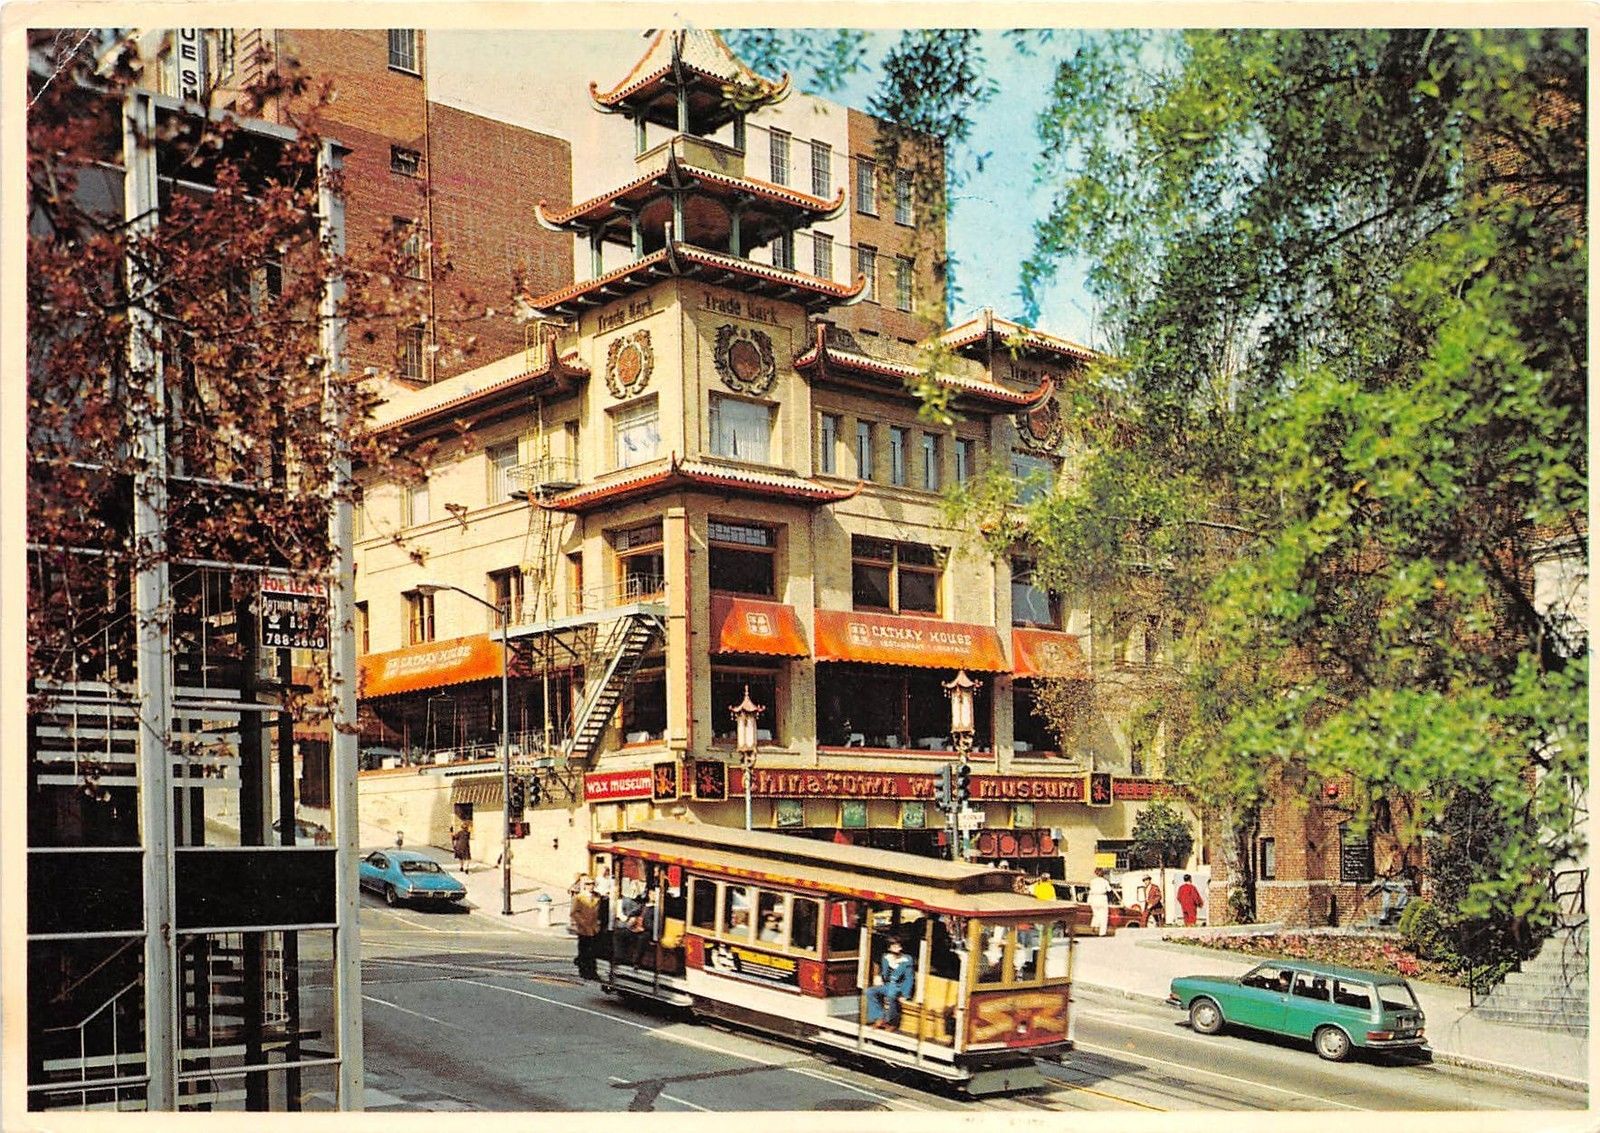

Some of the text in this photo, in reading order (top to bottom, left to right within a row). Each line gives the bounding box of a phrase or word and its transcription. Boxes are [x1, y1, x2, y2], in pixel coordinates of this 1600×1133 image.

[872, 626, 922, 641] CATHAY
[930, 631, 972, 646] HOUSE
[586, 776, 653, 793] wax museum
